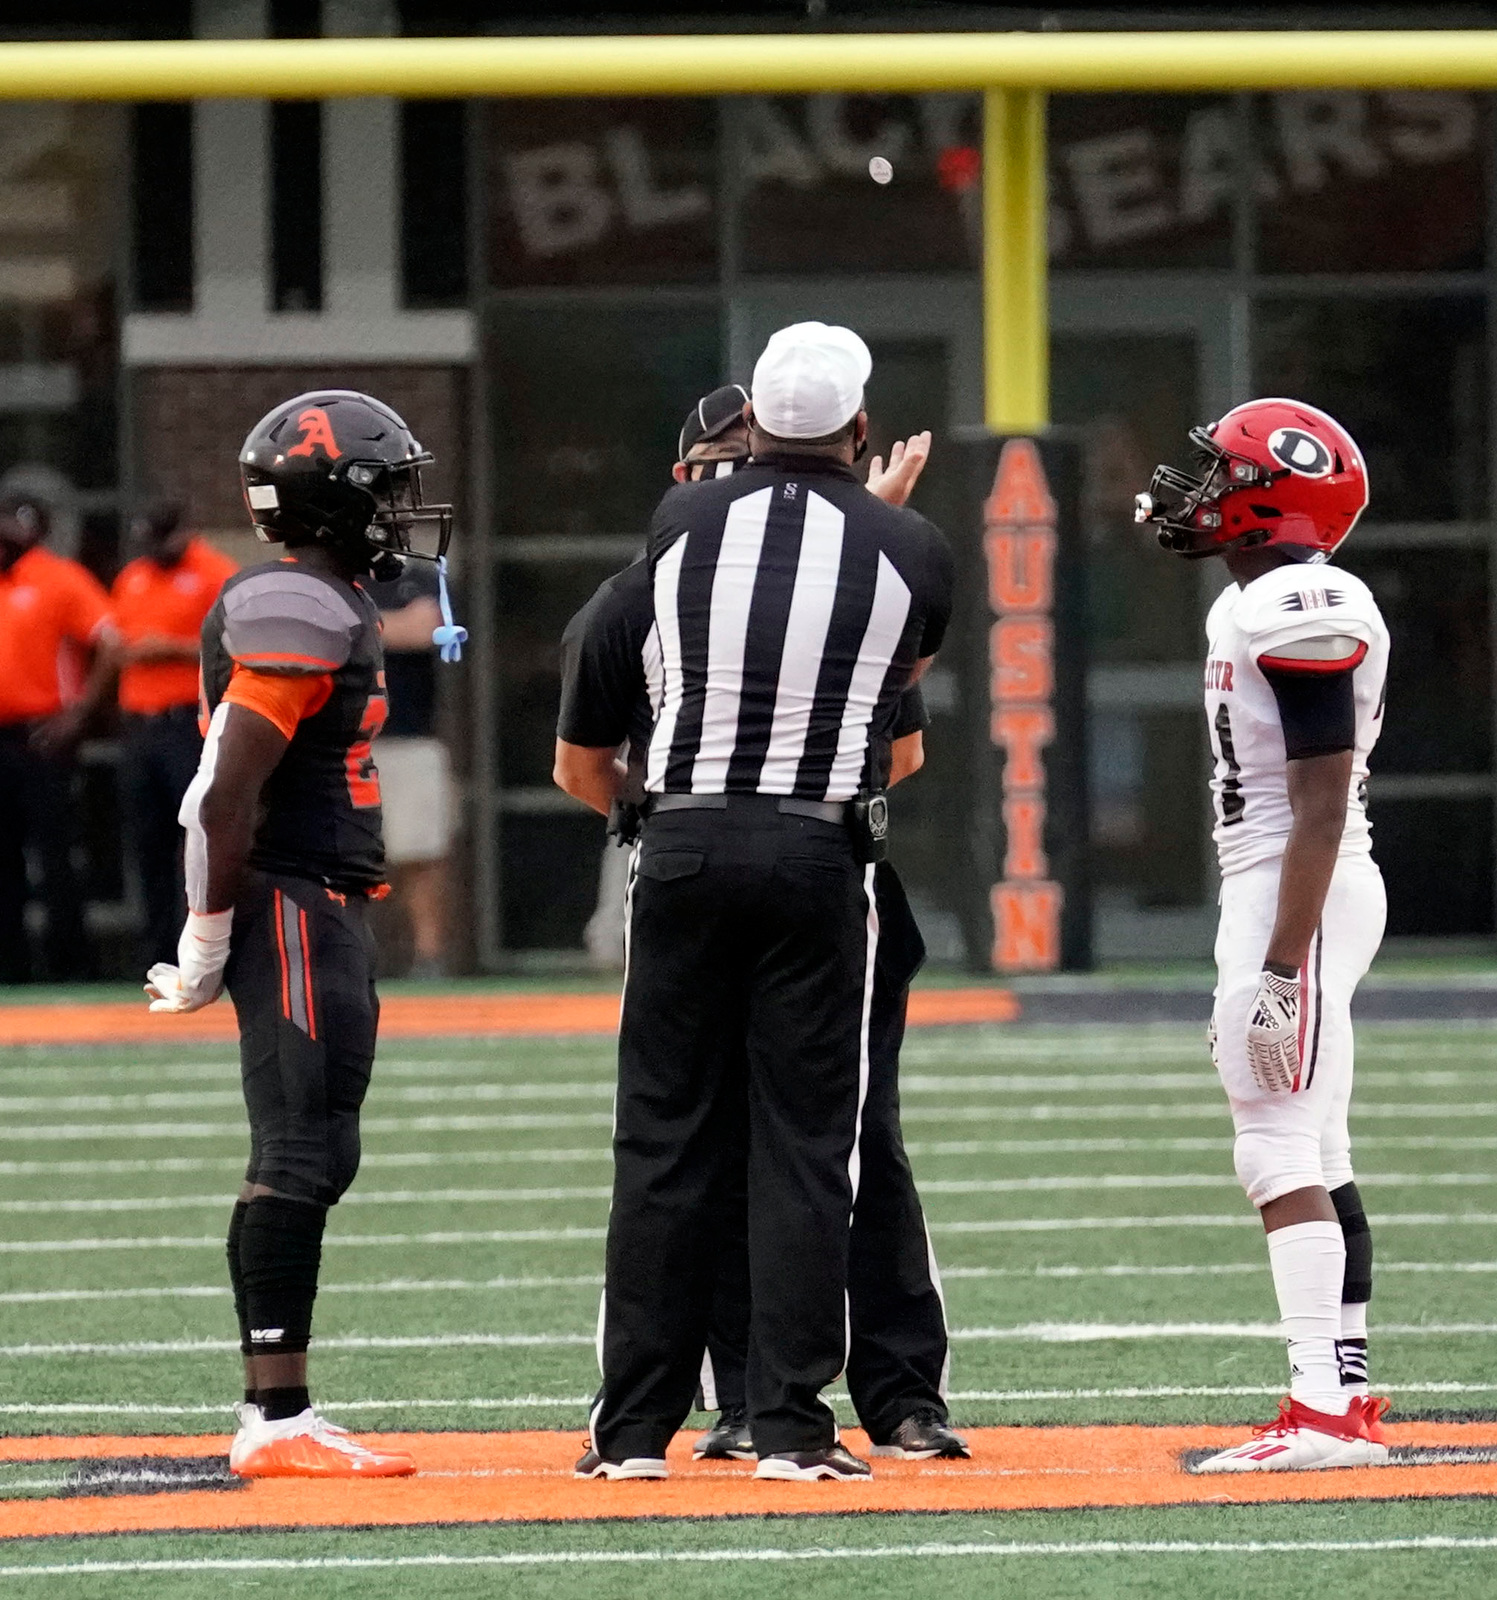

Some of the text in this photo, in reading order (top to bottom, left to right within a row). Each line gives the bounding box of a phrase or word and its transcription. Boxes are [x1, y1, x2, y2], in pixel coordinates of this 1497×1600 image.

[508, 93, 984, 258] BLAC
[964, 90, 1476, 265] EARS
[287, 408, 342, 460] A
[1271, 430, 1330, 476] D
[984, 438, 1065, 972] AUSTIN
